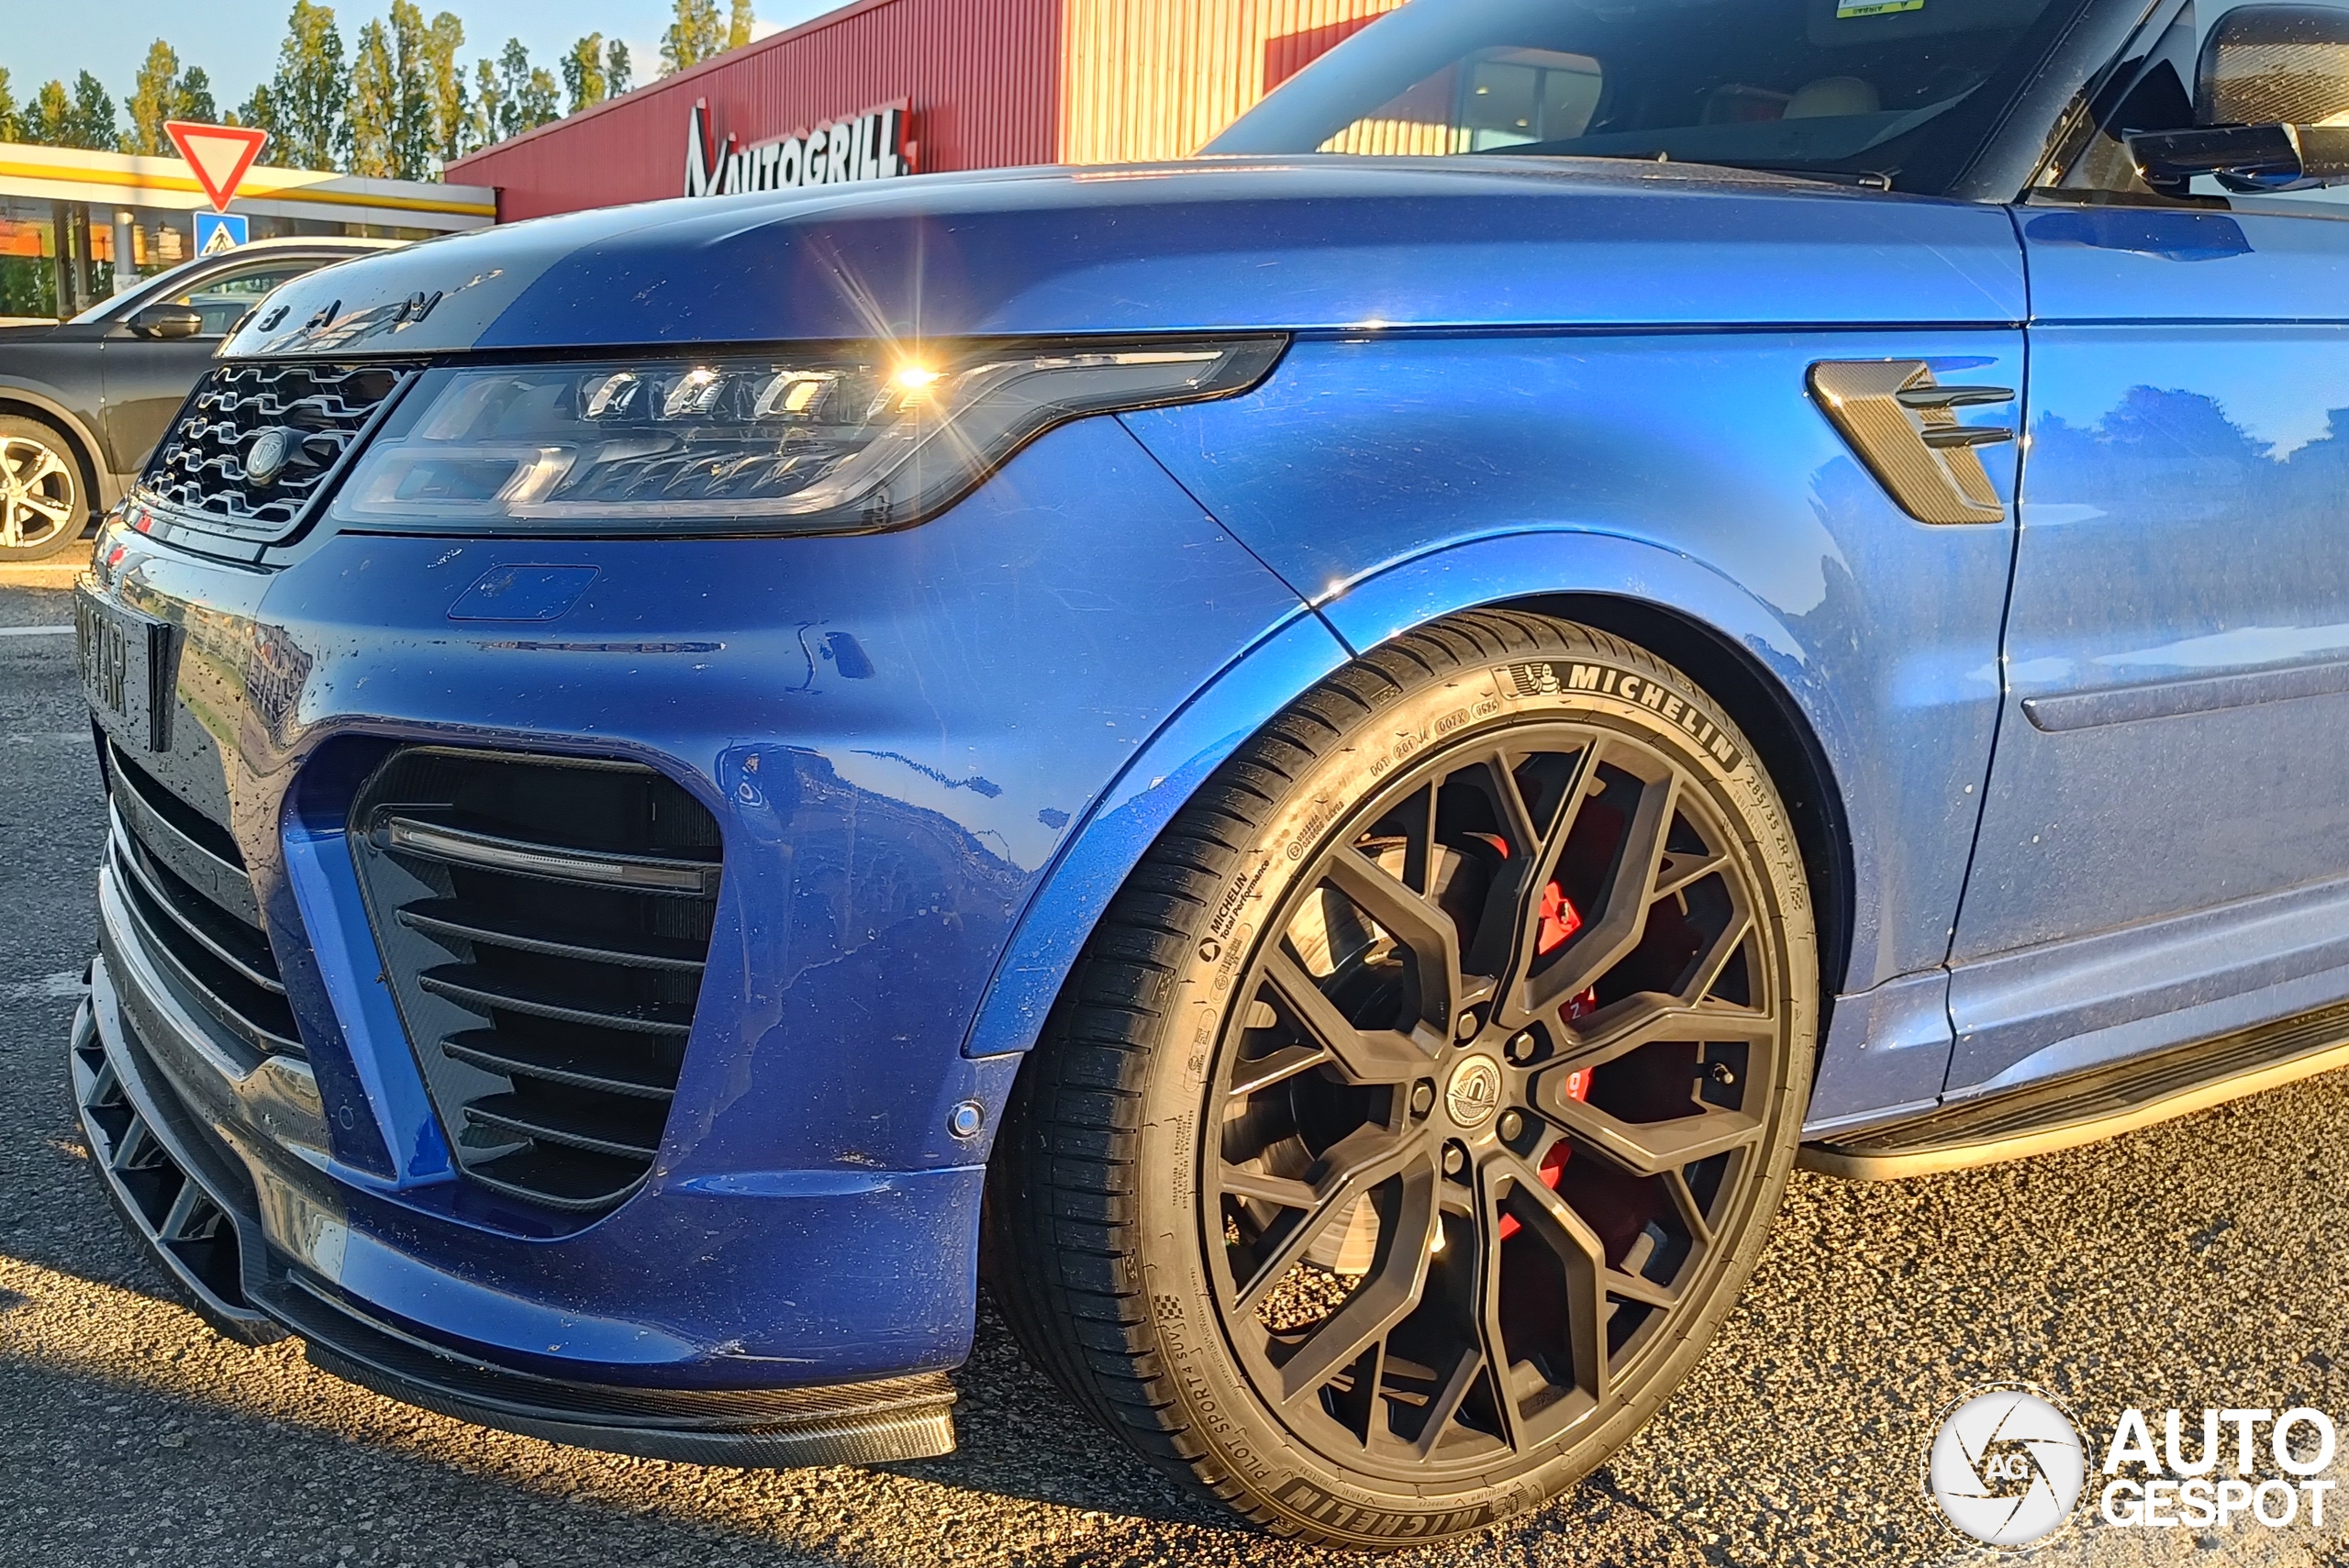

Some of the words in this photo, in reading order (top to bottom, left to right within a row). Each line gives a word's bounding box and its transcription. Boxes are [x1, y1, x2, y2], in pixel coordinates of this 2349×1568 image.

[1568, 664, 1735, 763] MICHELIN
[1745, 775, 1779, 830] 285/35
[1776, 835, 1788, 857] ZR
[1786, 861, 1797, 881] 23
[1210, 872, 1248, 934] MICHELIN
[1219, 915, 1236, 940] Total
[1233, 859, 1270, 917] Performance
[1169, 1332, 1188, 1360] SUV
[1182, 1366, 1193, 1374] 4
[1186, 1378, 1230, 1435] SPORT
[1224, 1440, 1271, 1480] PILOT
[1283, 1485, 1480, 1538] MICHELIN
